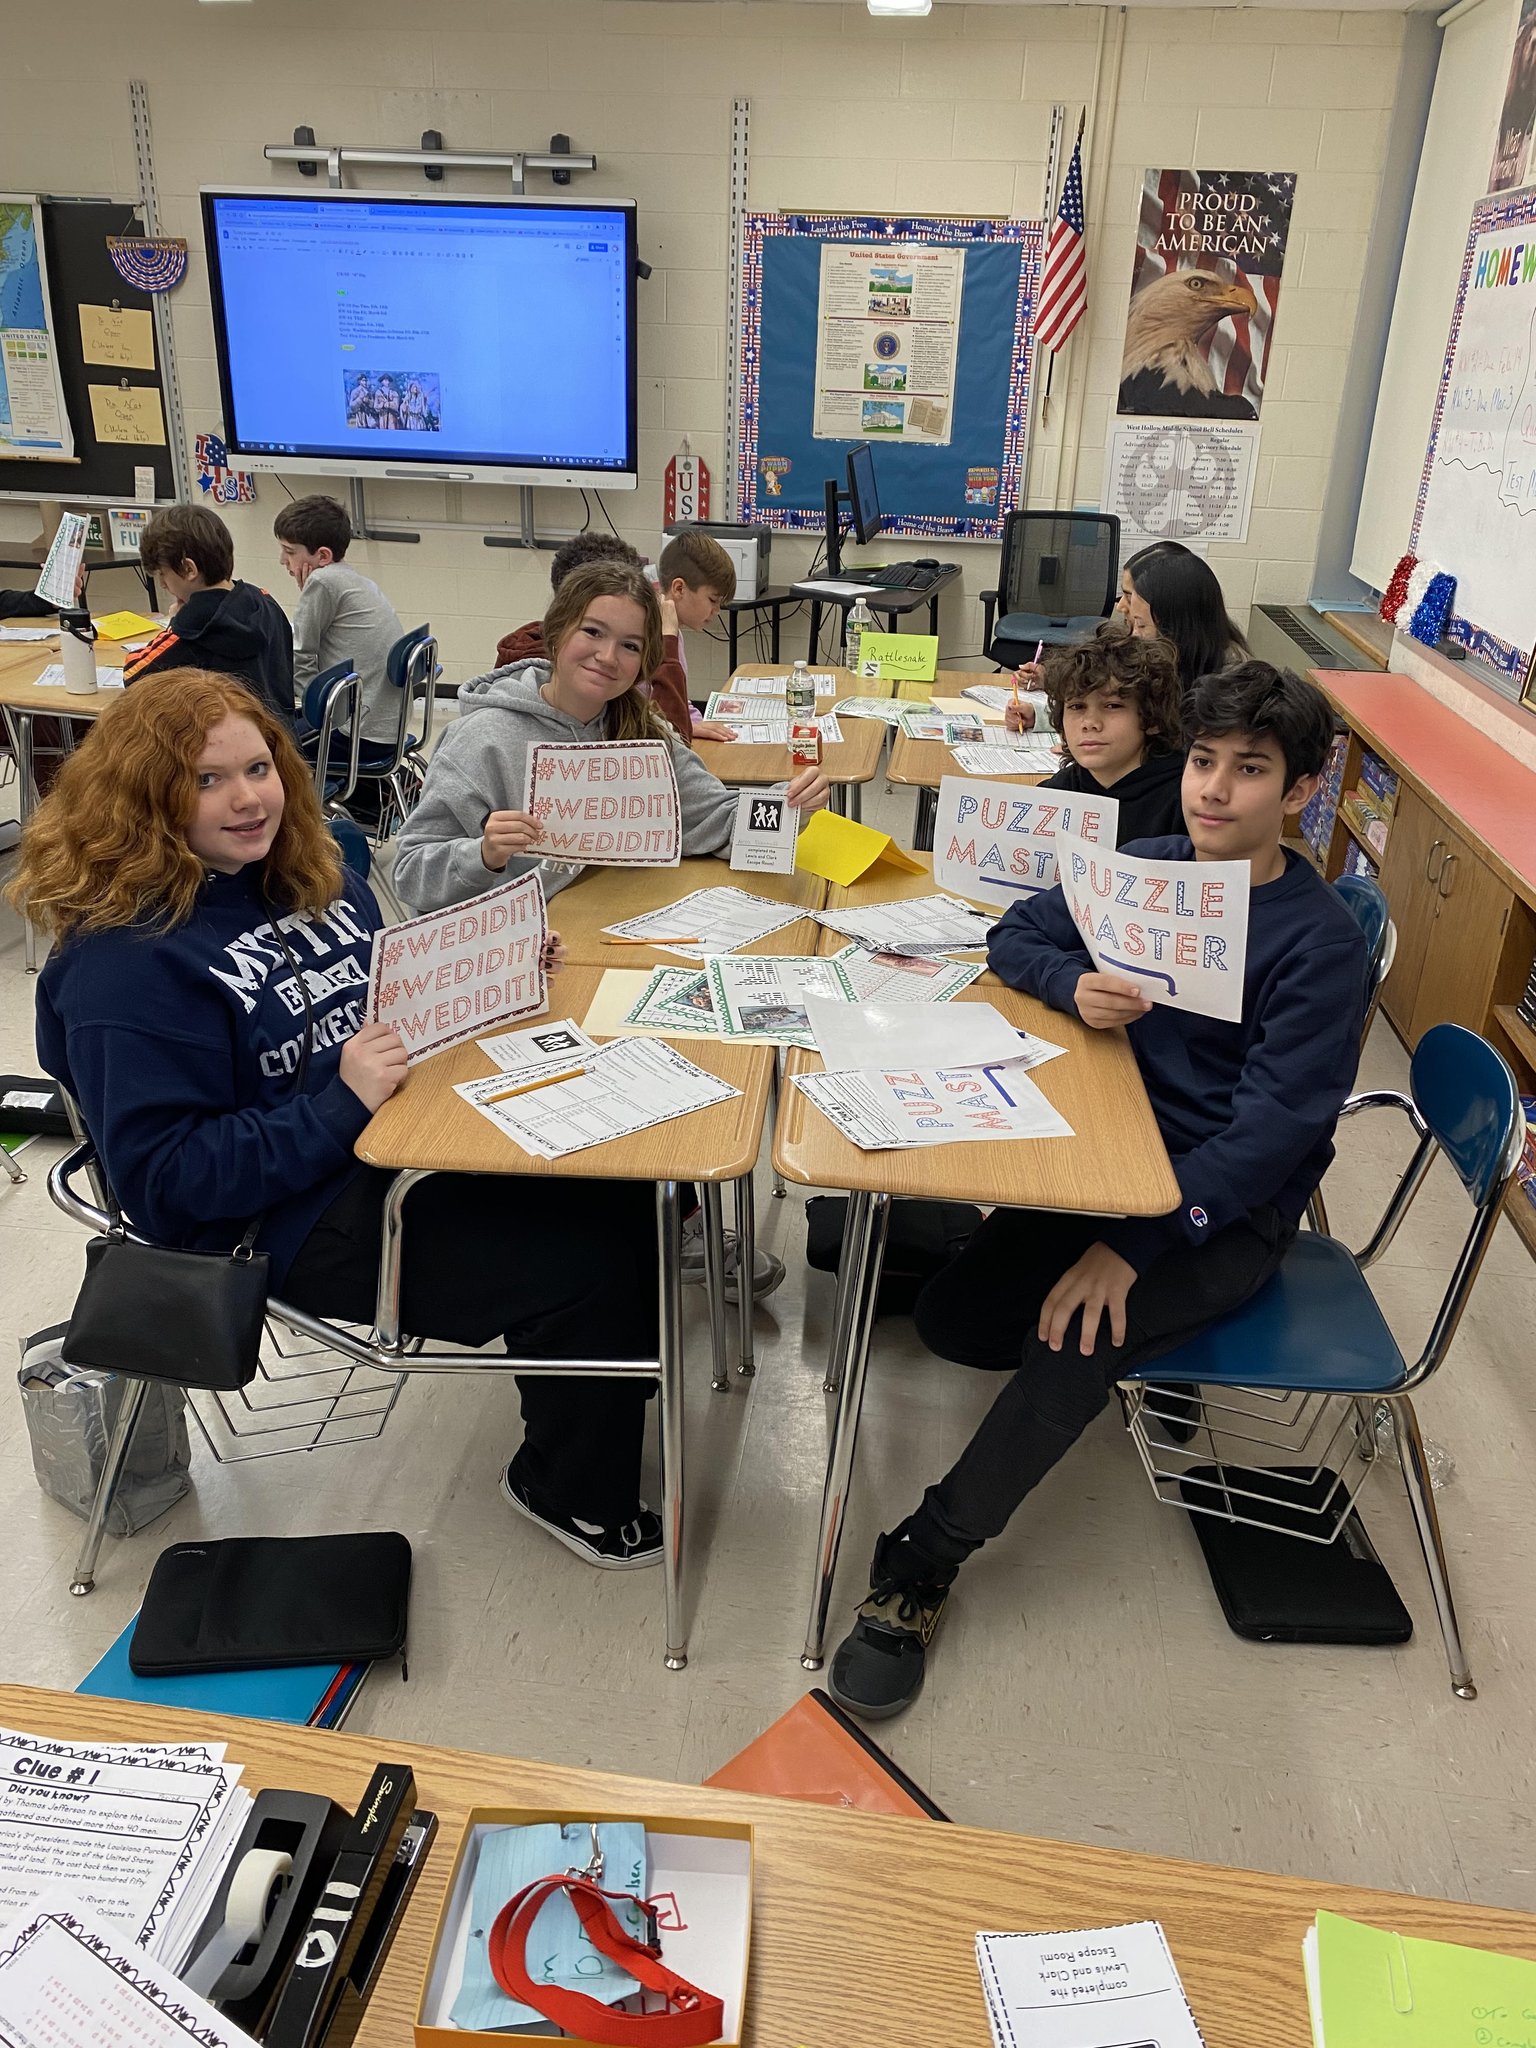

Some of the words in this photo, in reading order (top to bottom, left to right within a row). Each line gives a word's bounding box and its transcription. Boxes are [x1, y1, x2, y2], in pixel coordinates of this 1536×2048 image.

[1179, 192, 1256, 212] PROUD
[811, 223, 828, 233] Land
[829, 222, 837, 232] of
[838, 220, 850, 231] the
[851, 221, 868, 230] Free
[911, 222, 933, 232] Home
[932, 225, 941, 234] of
[941, 225, 953, 236] the
[954, 229, 973, 238] Brave
[1166, 213, 1196, 231] TO
[1203, 214, 1227, 232] BE
[1231, 215, 1262, 233] AN
[19, 239, 27, 268] Ocean
[1154, 233, 1268, 254] AMERICAN
[850, 251, 873, 259] United
[874, 252, 895, 260] States
[897, 253, 939, 261] Government
[12, 278, 24, 317] Atlantic
[124, 399, 142, 409] Not
[195, 434, 211, 462] I
[211, 474, 256, 503] USA!
[677, 472, 694, 519] US
[803, 518, 820, 527] Land
[897, 518, 917, 528] Home
[917, 520, 926, 530] of
[925, 521, 936, 532] the
[936, 525, 954, 533] Brave
[868, 646, 928, 664] Rattlesnake
[537, 755, 670, 782] #WEDIDIT!
[535, 794, 672, 820] #WEDIDIT!
[958, 796, 1101, 842] PUZZLE
[531, 830, 672, 852] #WEDIDIT!
[1072, 852, 1224, 917] PUZZLE
[384, 890, 537, 967] #WEDIDIT!
[1074, 895, 1228, 971] MASTER
[208, 900, 372, 1014] MYSTIC
[379, 934, 538, 1008] #WEDIDIT!
[13, 1757, 63, 1779] Clue
[66, 1766, 85, 1784] #
[88, 1769, 101, 1786] 1
[8, 1784, 27, 1795] Did
[29, 1788, 49, 1799] you
[51, 1789, 91, 1803] know?
[3, 1797, 13, 1806] by
[16, 1797, 45, 1810] Thomas
[47, 1801, 87, 1815] Jefferson
[88, 1808, 97, 1816] to
[98, 1810, 128, 1821] explore
[130, 1812, 142, 1821] the
[144, 1814, 183, 1826] Louisiana
[360, 1775, 393, 1836] Swingline
[36, 1813, 50, 1822] and
[52, 1815, 82, 1825] trained
[83, 1820, 104, 1829] more
[105, 1821, 124, 1831] than
[126, 1824, 139, 1832] 40
[139, 1827, 158, 1835] men.
[0, 1841, 21, 1851] nearly
[22, 1843, 51, 1854] doubled
[52, 1847, 64, 1856] the
[69, 1849, 81, 1857] size
[82, 1850, 91, 1859] of
[92, 1852, 104, 1860] the
[106, 1854, 130, 1863] United
[131, 1856, 154, 1865] States
[23, 1831, 35, 1841] 3rd
[72, 1839, 93, 1848] made
[94, 1842, 106, 1850] the
[107, 1843, 142, 1853] Louisiana
[144, 1846, 177, 1857] Purchase
[0, 1852, 18, 1861] miles
[19, 1854, 29, 1864] of
[30, 1855, 46, 1865] land.
[52, 1857, 65, 1867] The
[66, 1860, 82, 1869] cost
[83, 1862, 100, 1871] back
[102, 1864, 119, 1873] then
[136, 1868, 152, 1878] only
[1, 1864, 25, 1873] would
[25, 1867, 53, 1876] convert
[54, 1870, 62, 1878] to
[98, 1874, 129, 1885] hundred
[129, 1877, 147, 1888] fifty
[8, 1887, 27, 1896] from
[85, 1896, 107, 1904] River
[108, 1897, 115, 1906] to
[117, 1899, 130, 1907] the
[96, 1908, 127, 1918] Orleans
[128, 1910, 136, 1918] to
[1040, 1954, 1076, 1965] Room!
[1078, 1946, 1117, 1959] Escape
[1038, 1971, 1070, 1982] Clark
[1073, 1967, 1092, 1979] and
[1095, 1962, 1130, 1974] Lewis
[1050, 1988, 1069, 1998] the
[1072, 1980, 1128, 1996] completed
